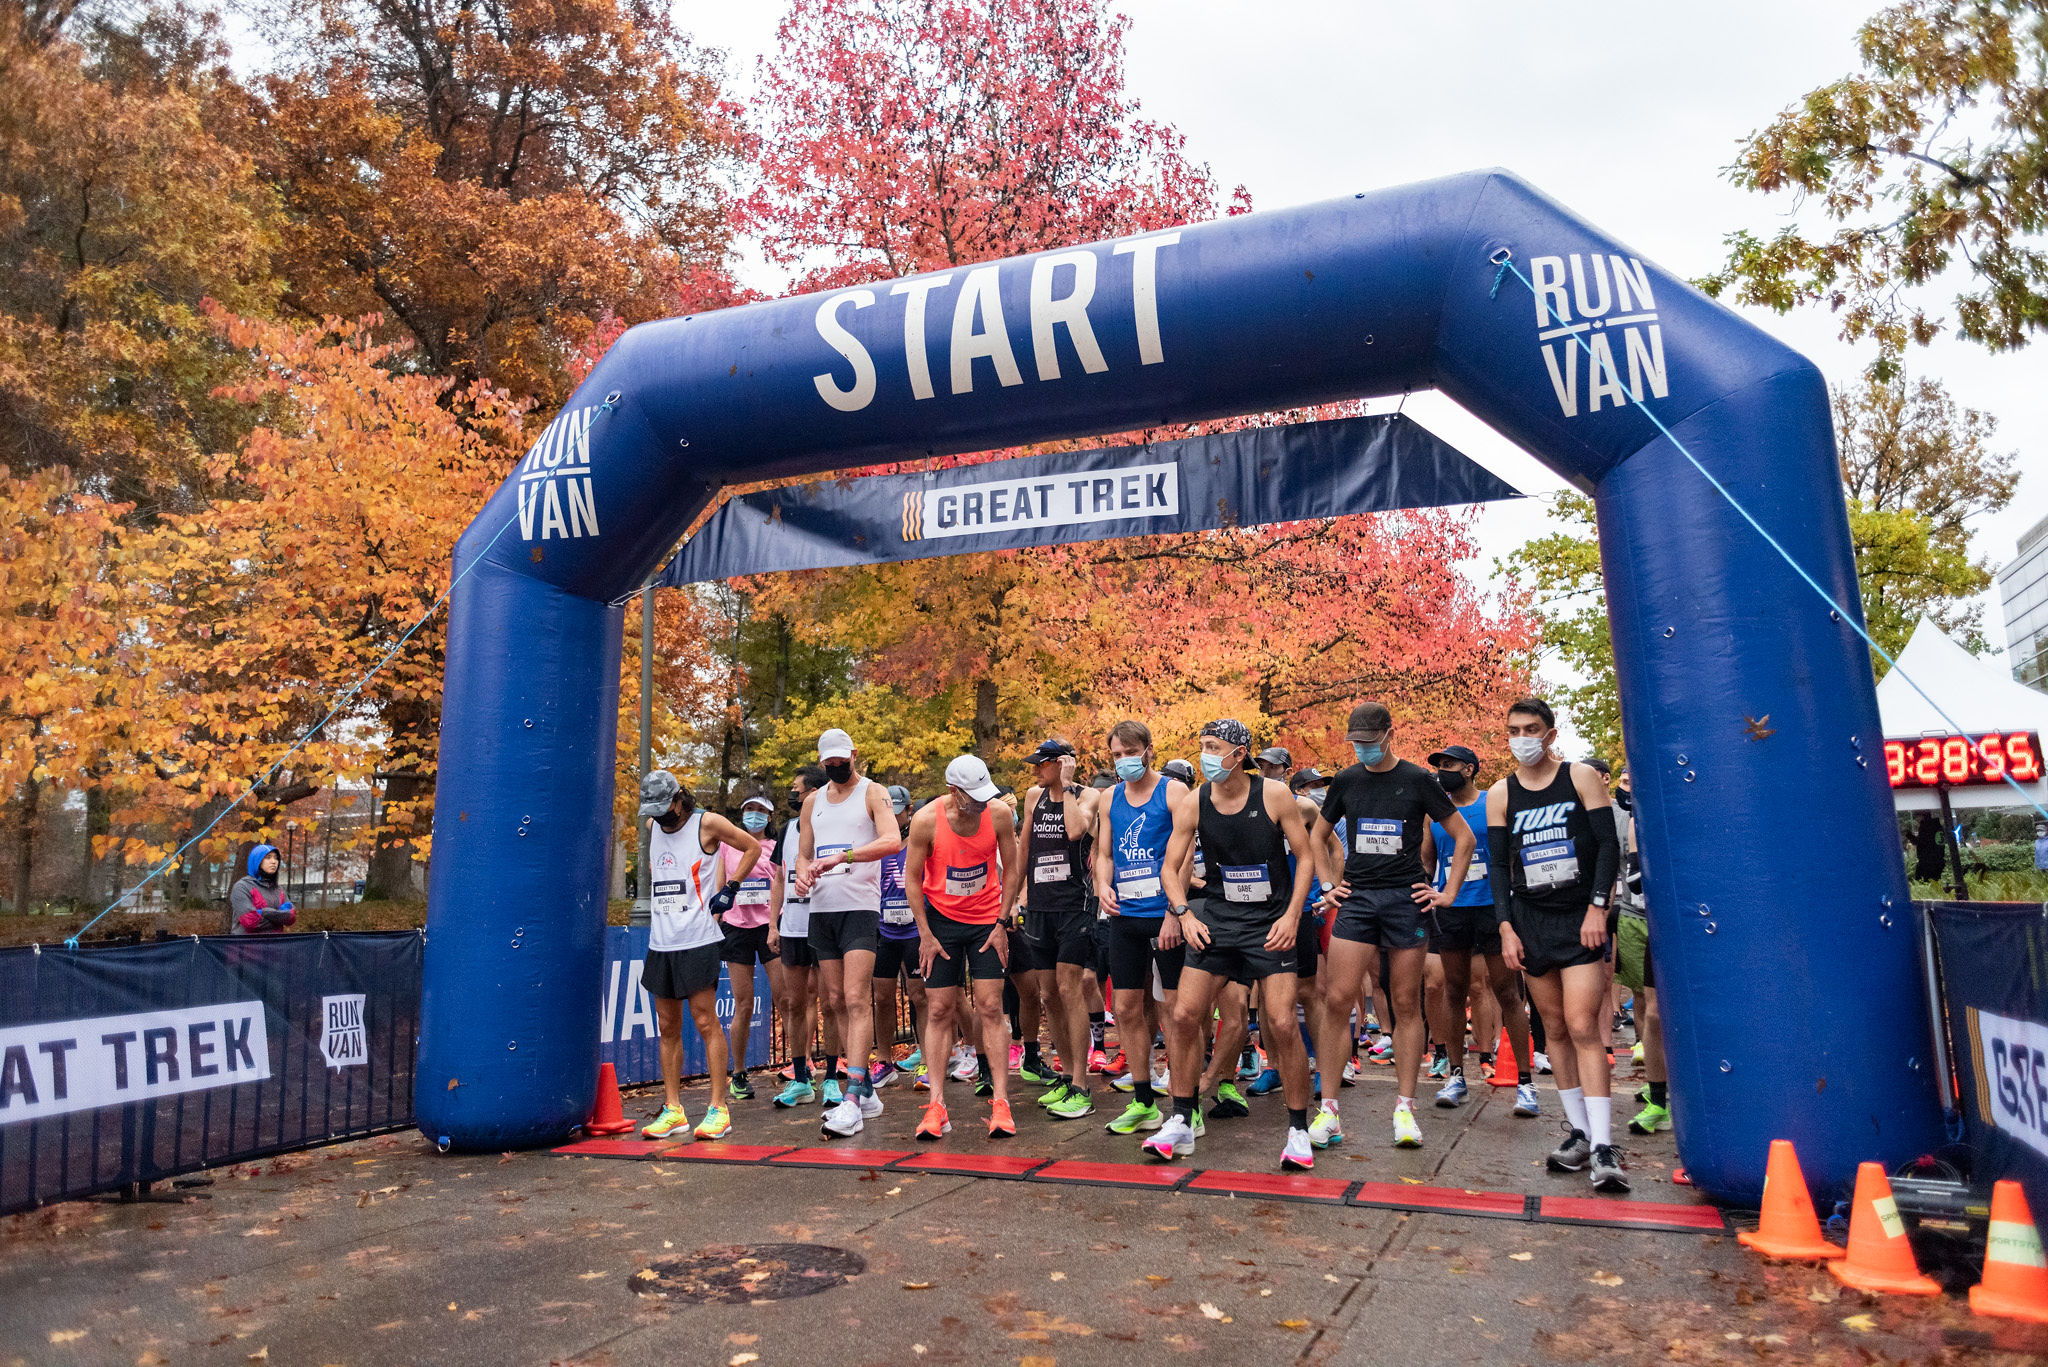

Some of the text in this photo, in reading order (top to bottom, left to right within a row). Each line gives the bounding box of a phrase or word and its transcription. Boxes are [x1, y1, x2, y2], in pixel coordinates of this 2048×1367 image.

[1530, 253, 1656, 328] RUN
[813, 232, 1182, 412] START
[1540, 324, 1669, 418] VAN
[522, 406, 592, 473] RUN
[518, 477, 601, 541] VAN
[937, 472, 1169, 529] GREAT TREK
[1033, 822, 1065, 833] balanc
[1042, 813, 1064, 821] new
[1512, 801, 1576, 834] TUXC
[1522, 827, 1567, 845] ALUMNI
[1124, 848, 1154, 859] VFAC
[1532, 850, 1549, 859] GREAT
[1541, 863, 1558, 872] RORY
[960, 881, 976, 889] CRAIG
[1245, 870, 1261, 878] TREK
[1237, 885, 1253, 893] GABE
[329, 1001, 360, 1029] RUN
[601, 959, 661, 1043] VA
[101, 1016, 256, 1090] TREK
[328, 1031, 362, 1060] VAN
